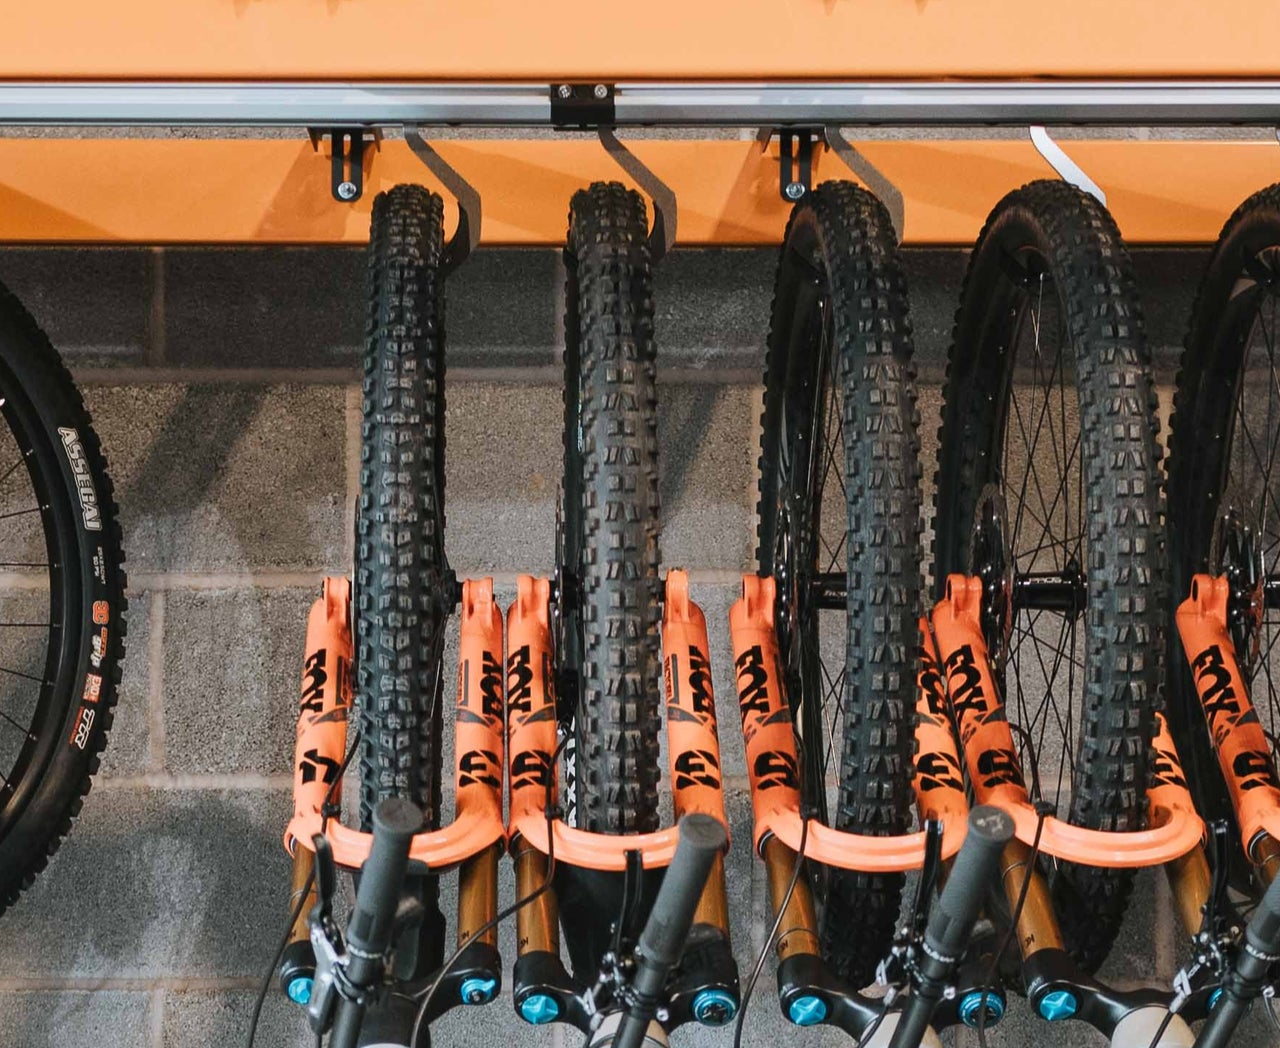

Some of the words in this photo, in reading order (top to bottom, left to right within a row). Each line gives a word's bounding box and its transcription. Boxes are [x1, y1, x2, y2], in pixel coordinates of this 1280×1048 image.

[58, 427, 103, 531] ASSEGAI
[735, 645, 771, 720] FOX
[945, 644, 988, 726] FOX
[1191, 644, 1241, 732] FOX
